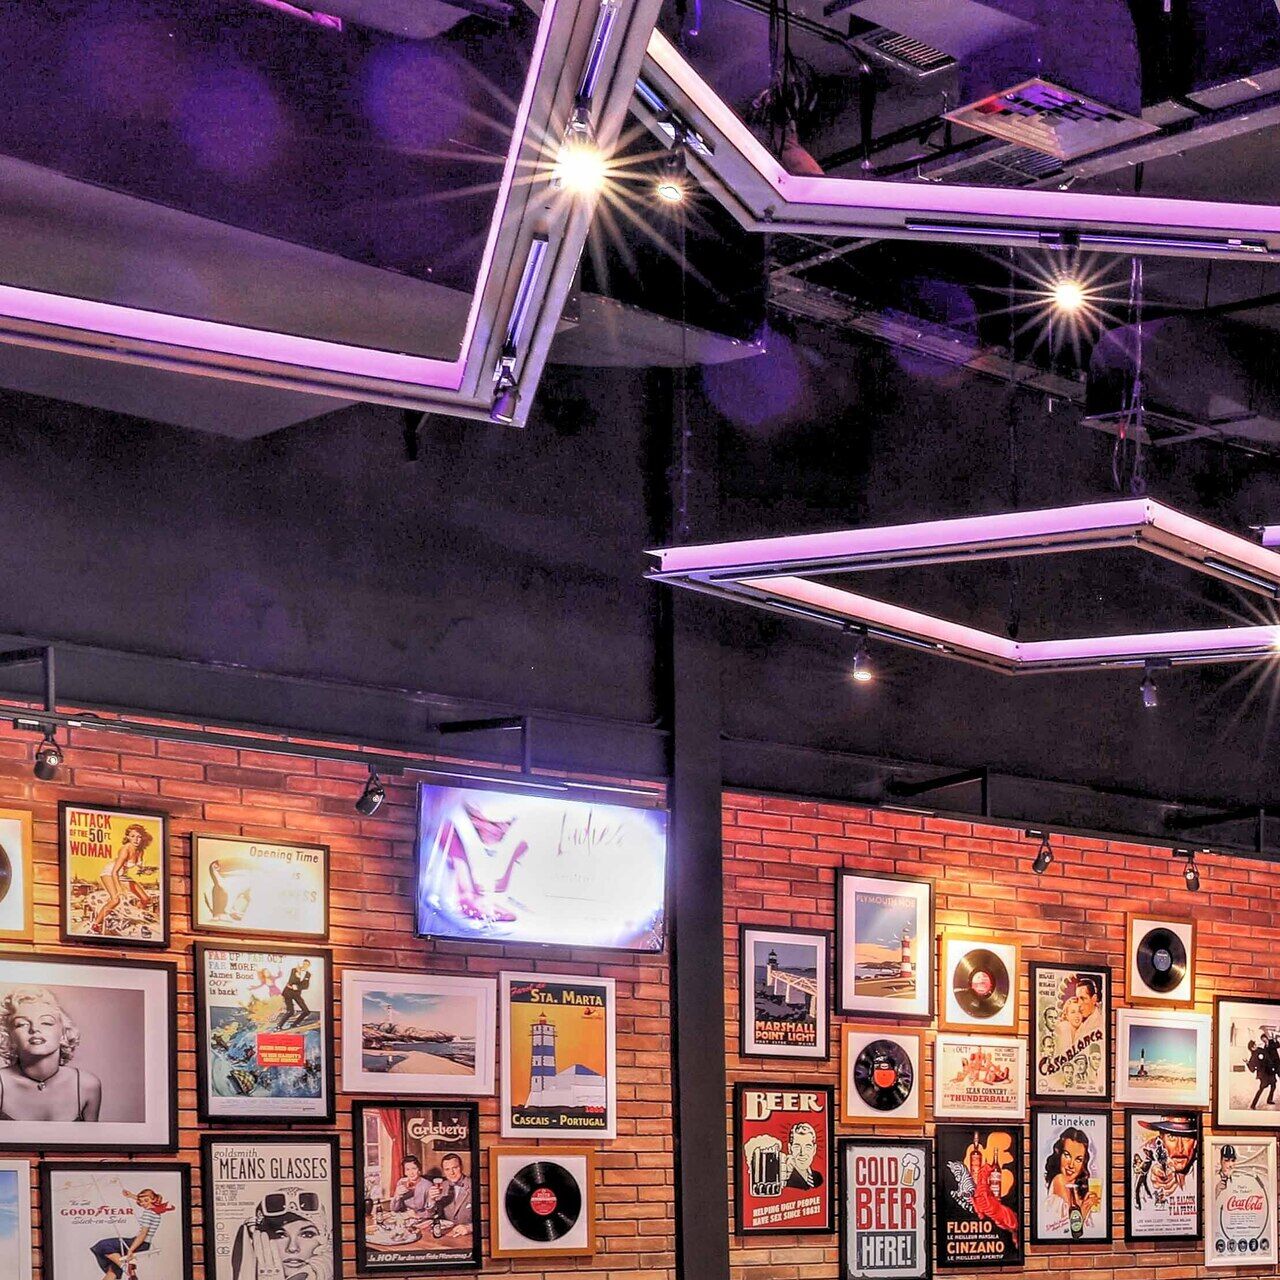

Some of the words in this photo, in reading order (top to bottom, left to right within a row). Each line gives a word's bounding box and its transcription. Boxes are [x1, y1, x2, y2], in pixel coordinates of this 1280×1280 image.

[70, 811, 111, 829] ATTACK
[89, 829, 103, 842] 50
[70, 840, 112, 858] WOMAN
[249, 846, 292, 863] Opening
[295, 851, 319, 863] Time
[209, 971, 233, 979] James
[562, 991, 603, 1006] MARTA
[755, 1021, 815, 1033] MARSHALL
[755, 1031, 785, 1040] POINT
[788, 1033, 815, 1042] LIGHT
[1039, 1029, 1103, 1076] CASABLANCA
[745, 1091, 823, 1120] BEER
[512, 1114, 549, 1125] CASCAIS
[560, 1114, 605, 1126] PORTUGAL
[1051, 1114, 1096, 1127] Heineken
[407, 1118, 467, 1144] Carlsberg
[214, 1148, 258, 1161] goldsmith
[220, 1158, 265, 1179] MEANS
[271, 1158, 328, 1179] GLASSES
[856, 1156, 899, 1186] COLD
[60, 1205, 134, 1217] GOODYEAR
[752, 1204, 780, 1217] HELPING
[780, 1201, 796, 1211] UGLY
[796, 1196, 821, 1208] PEOPLE
[856, 1188, 917, 1230] BEER
[752, 1215, 769, 1227] HAVE
[769, 1213, 783, 1223] SEX
[783, 1209, 801, 1220] SINCE
[947, 1221, 992, 1233] FLORIO
[861, 1235, 912, 1267] HERE!
[947, 1241, 1005, 1254] CINZANO
[378, 1253, 398, 1262] HOF
